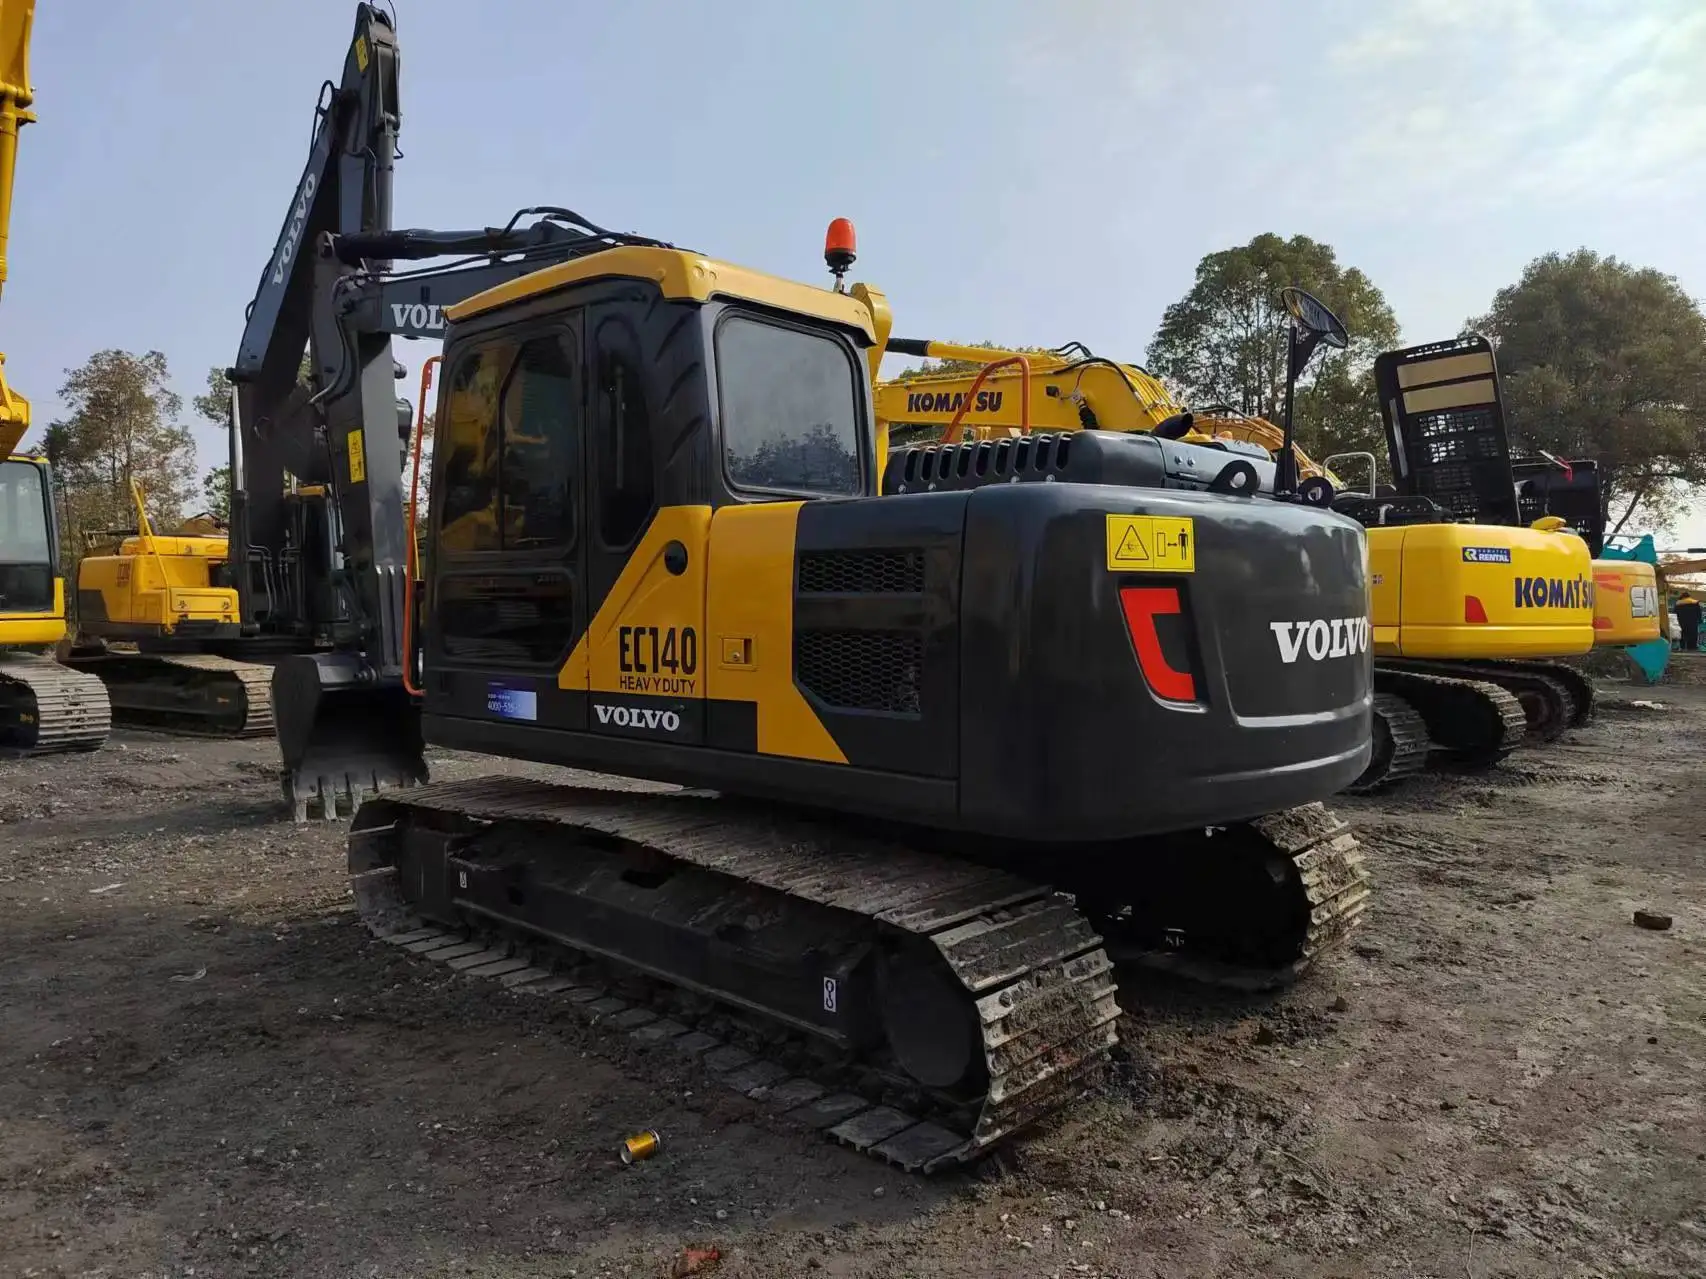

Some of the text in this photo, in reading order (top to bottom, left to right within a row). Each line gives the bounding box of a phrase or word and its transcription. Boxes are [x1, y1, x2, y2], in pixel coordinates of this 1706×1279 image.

[272, 173, 316, 285] VOLVO
[390, 303, 446, 330] VOL
[620, 626, 696, 675] EC140
[1270, 616, 1368, 663] VOLVO
[593, 704, 680, 732] VOLVO
